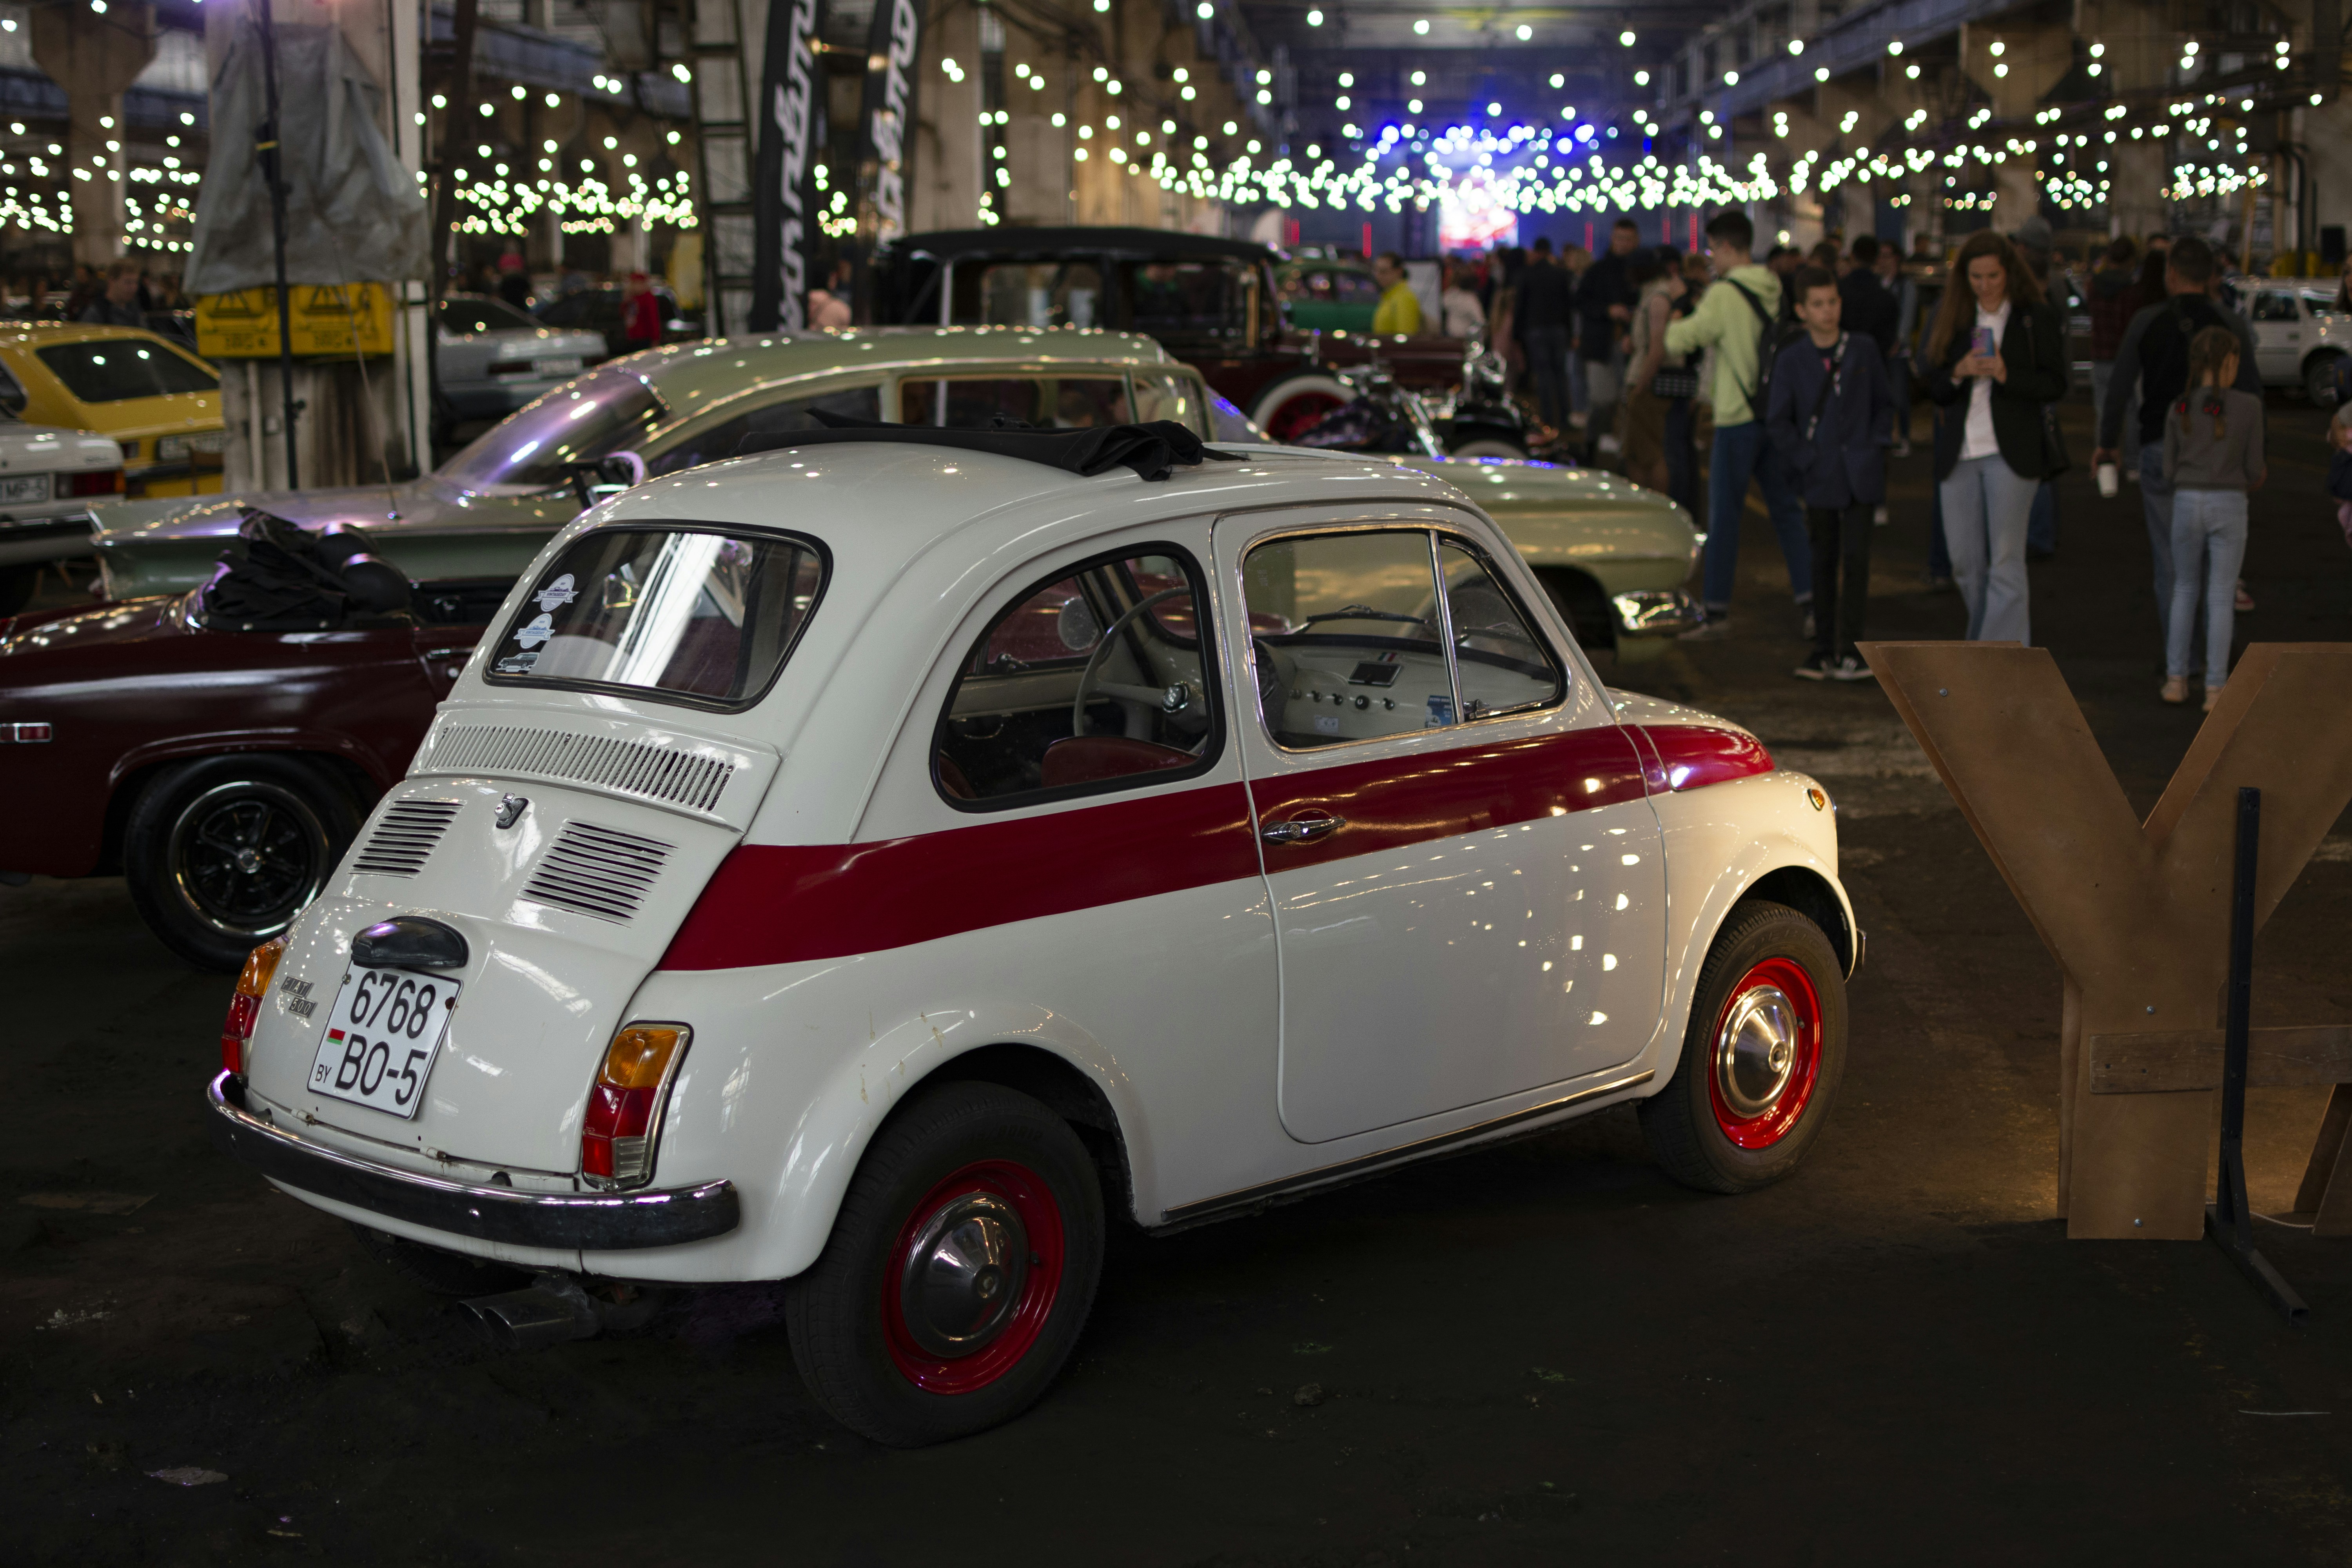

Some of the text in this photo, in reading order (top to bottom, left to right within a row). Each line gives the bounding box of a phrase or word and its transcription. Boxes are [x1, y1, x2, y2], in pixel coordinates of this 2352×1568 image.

[282, 978, 309, 994] FIAT
[291, 999, 311, 1014] 500
[350, 971, 436, 1039] 6768
[315, 1064, 332, 1083] BY
[335, 1034, 427, 1105] BO-5
